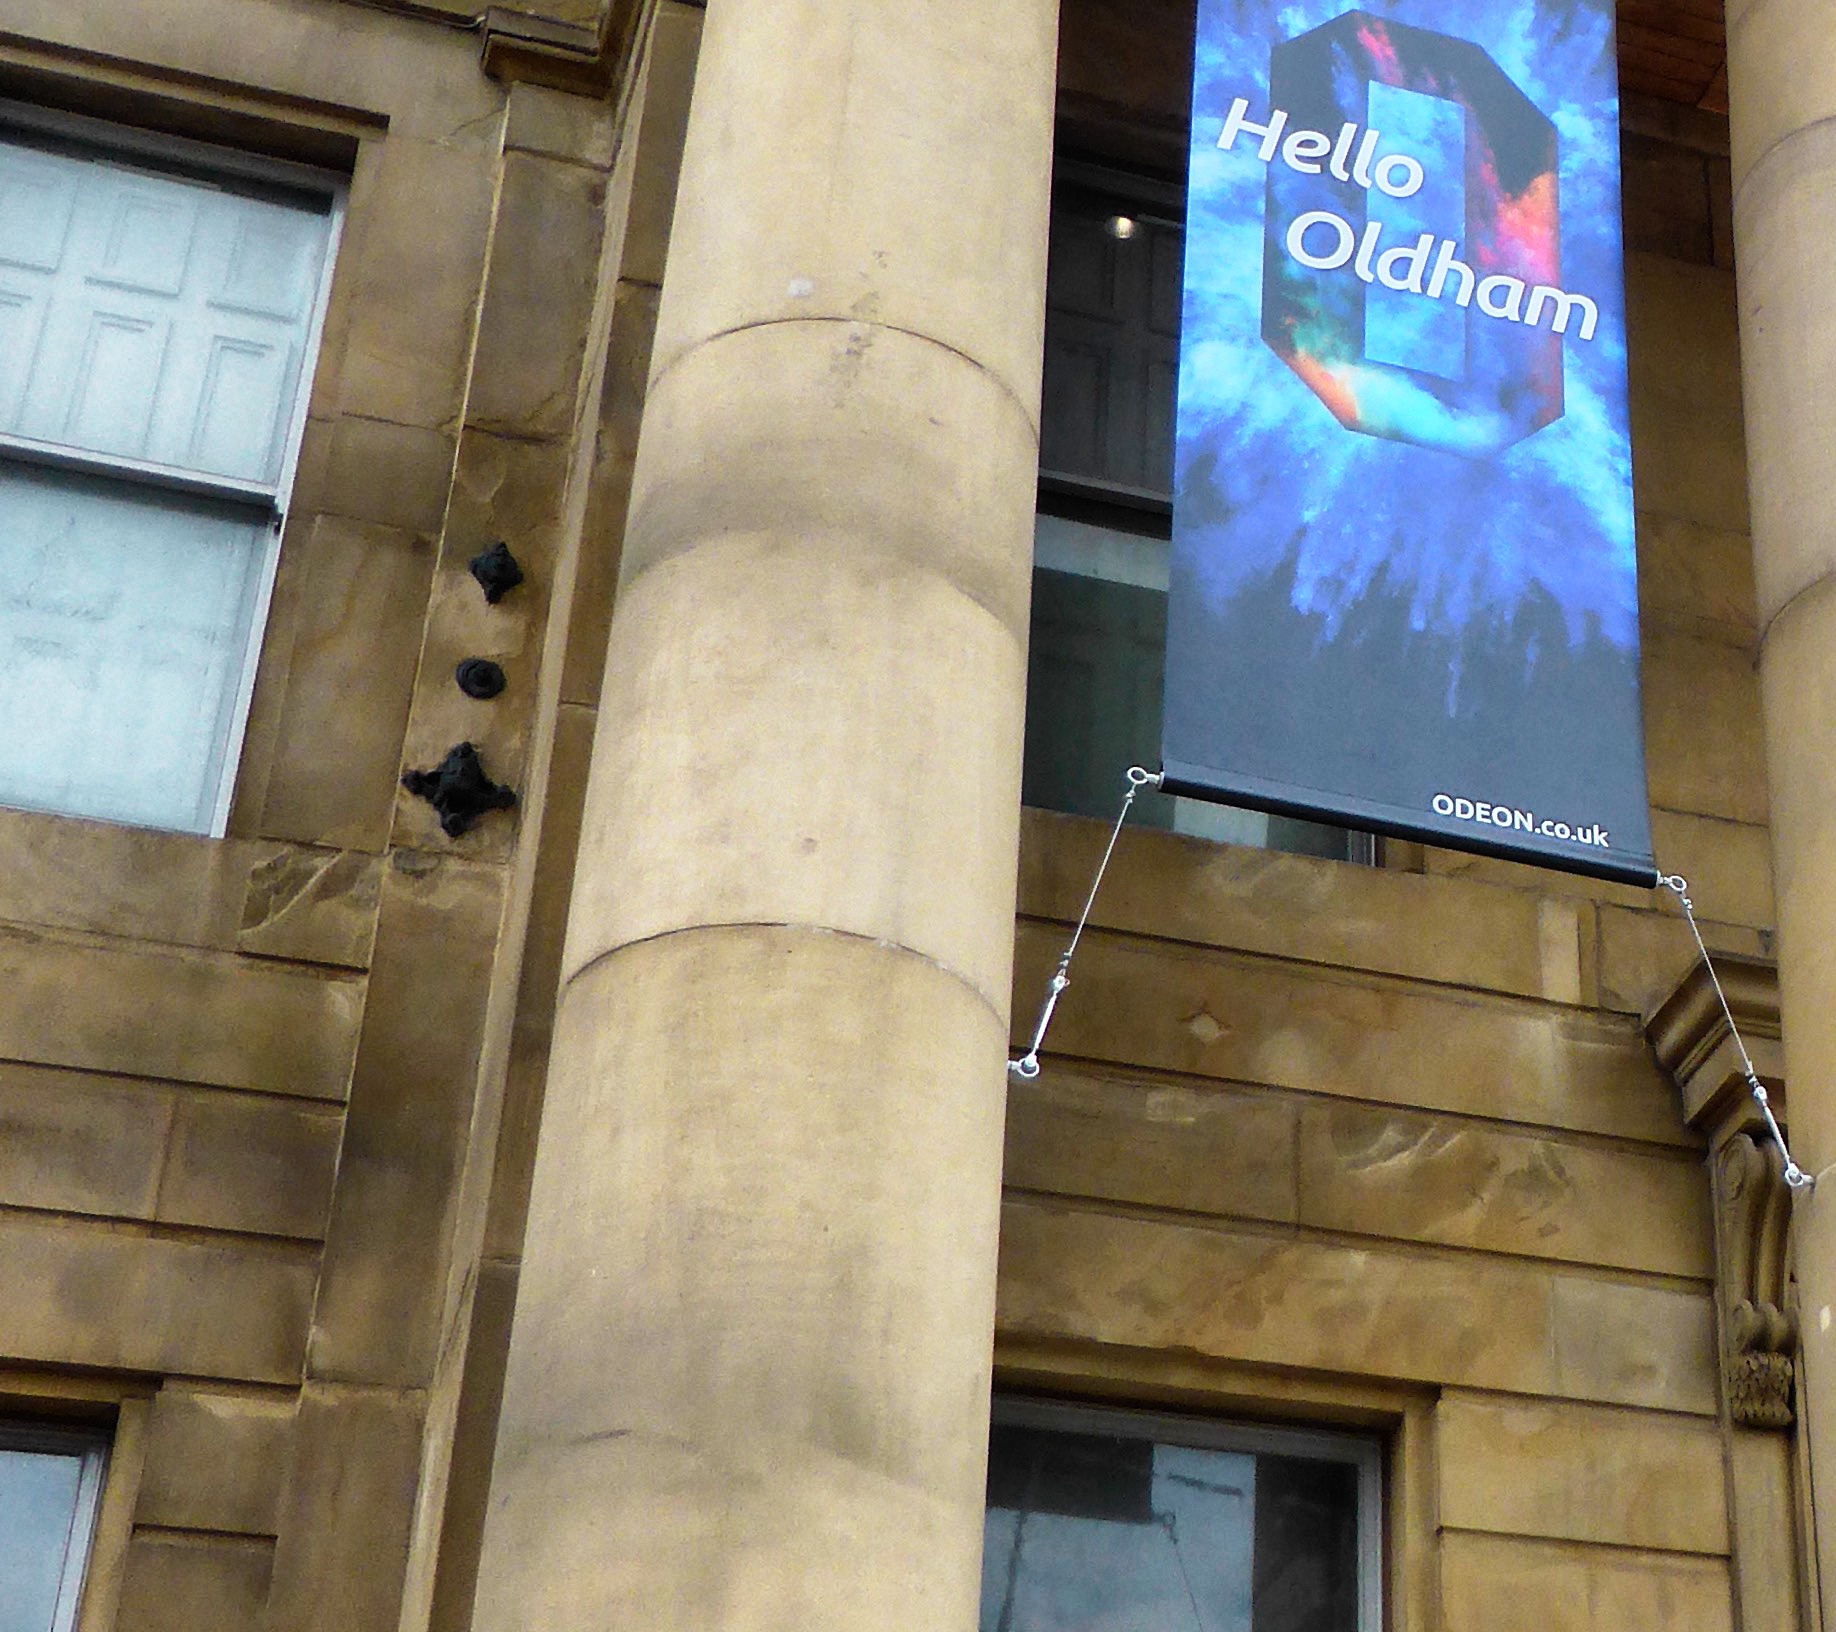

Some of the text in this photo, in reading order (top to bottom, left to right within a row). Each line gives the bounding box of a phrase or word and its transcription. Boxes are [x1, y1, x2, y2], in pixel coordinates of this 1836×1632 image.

[1216, 98, 1425, 199] Hello
[1285, 209, 1599, 341] Oldham
[1432, 794, 1609, 848] ODEON.co.uk
